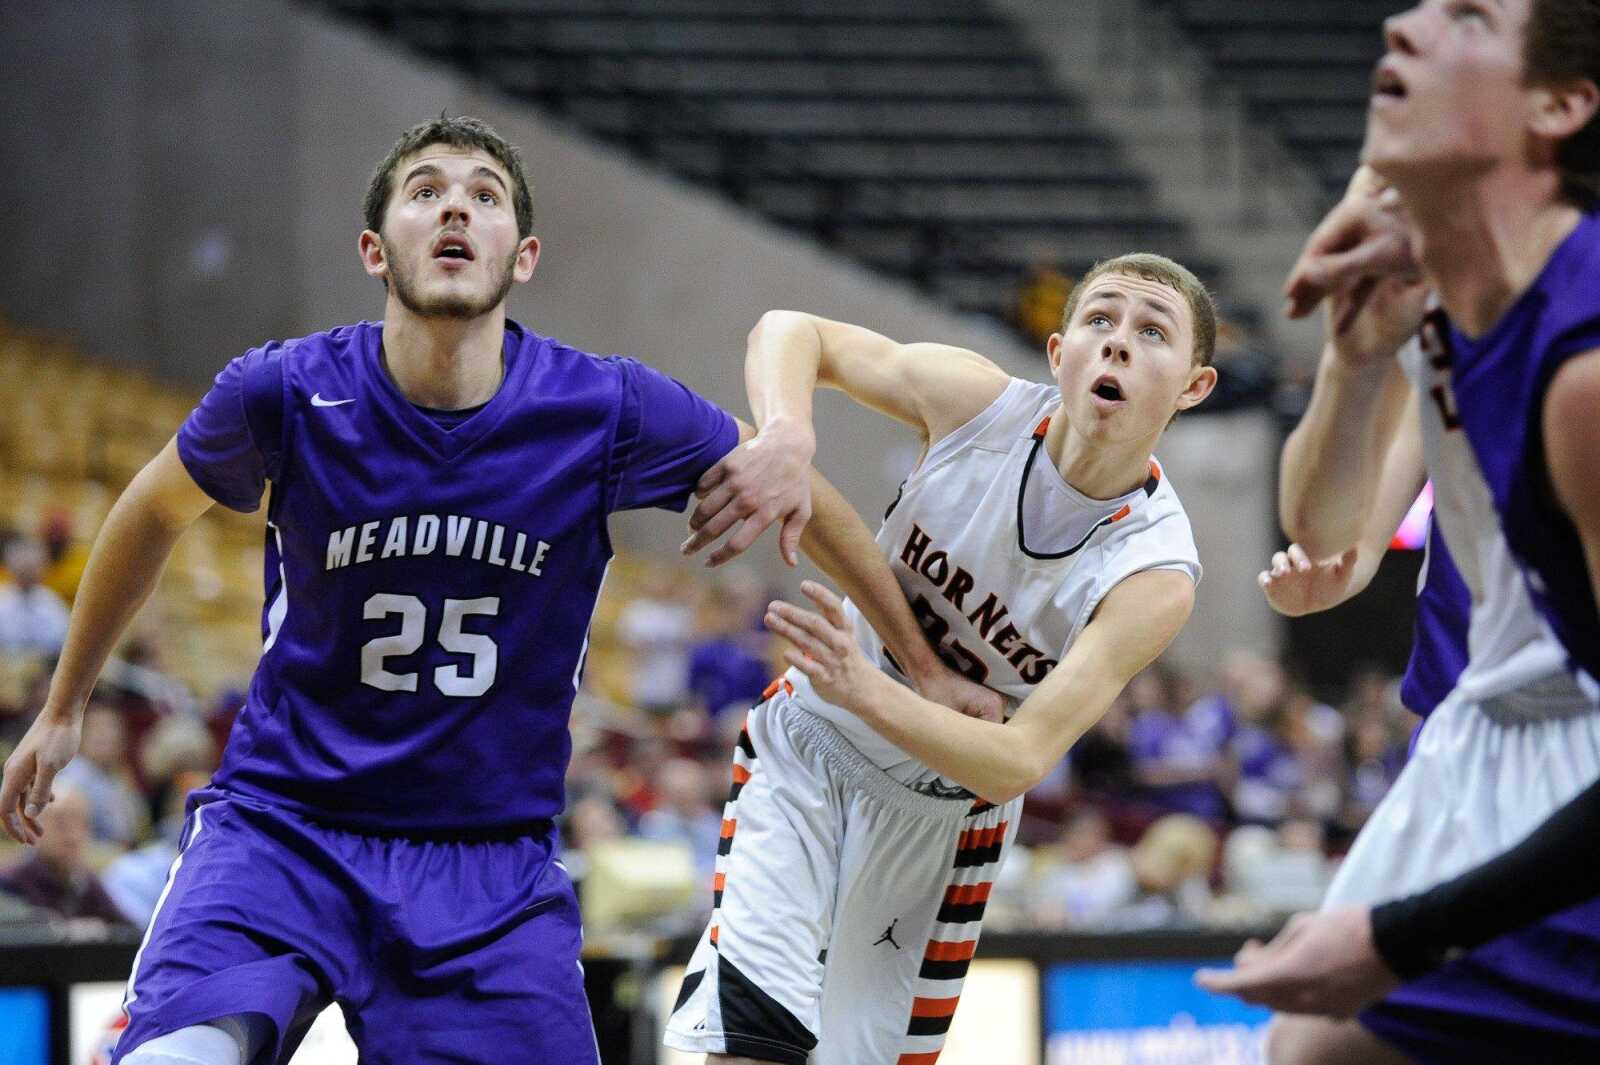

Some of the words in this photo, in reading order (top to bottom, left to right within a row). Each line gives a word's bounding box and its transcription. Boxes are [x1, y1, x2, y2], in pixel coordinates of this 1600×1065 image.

[325, 514, 551, 577] MEADVILLE
[360, 593, 500, 697] 25
[900, 523, 1058, 685] HORNETS
